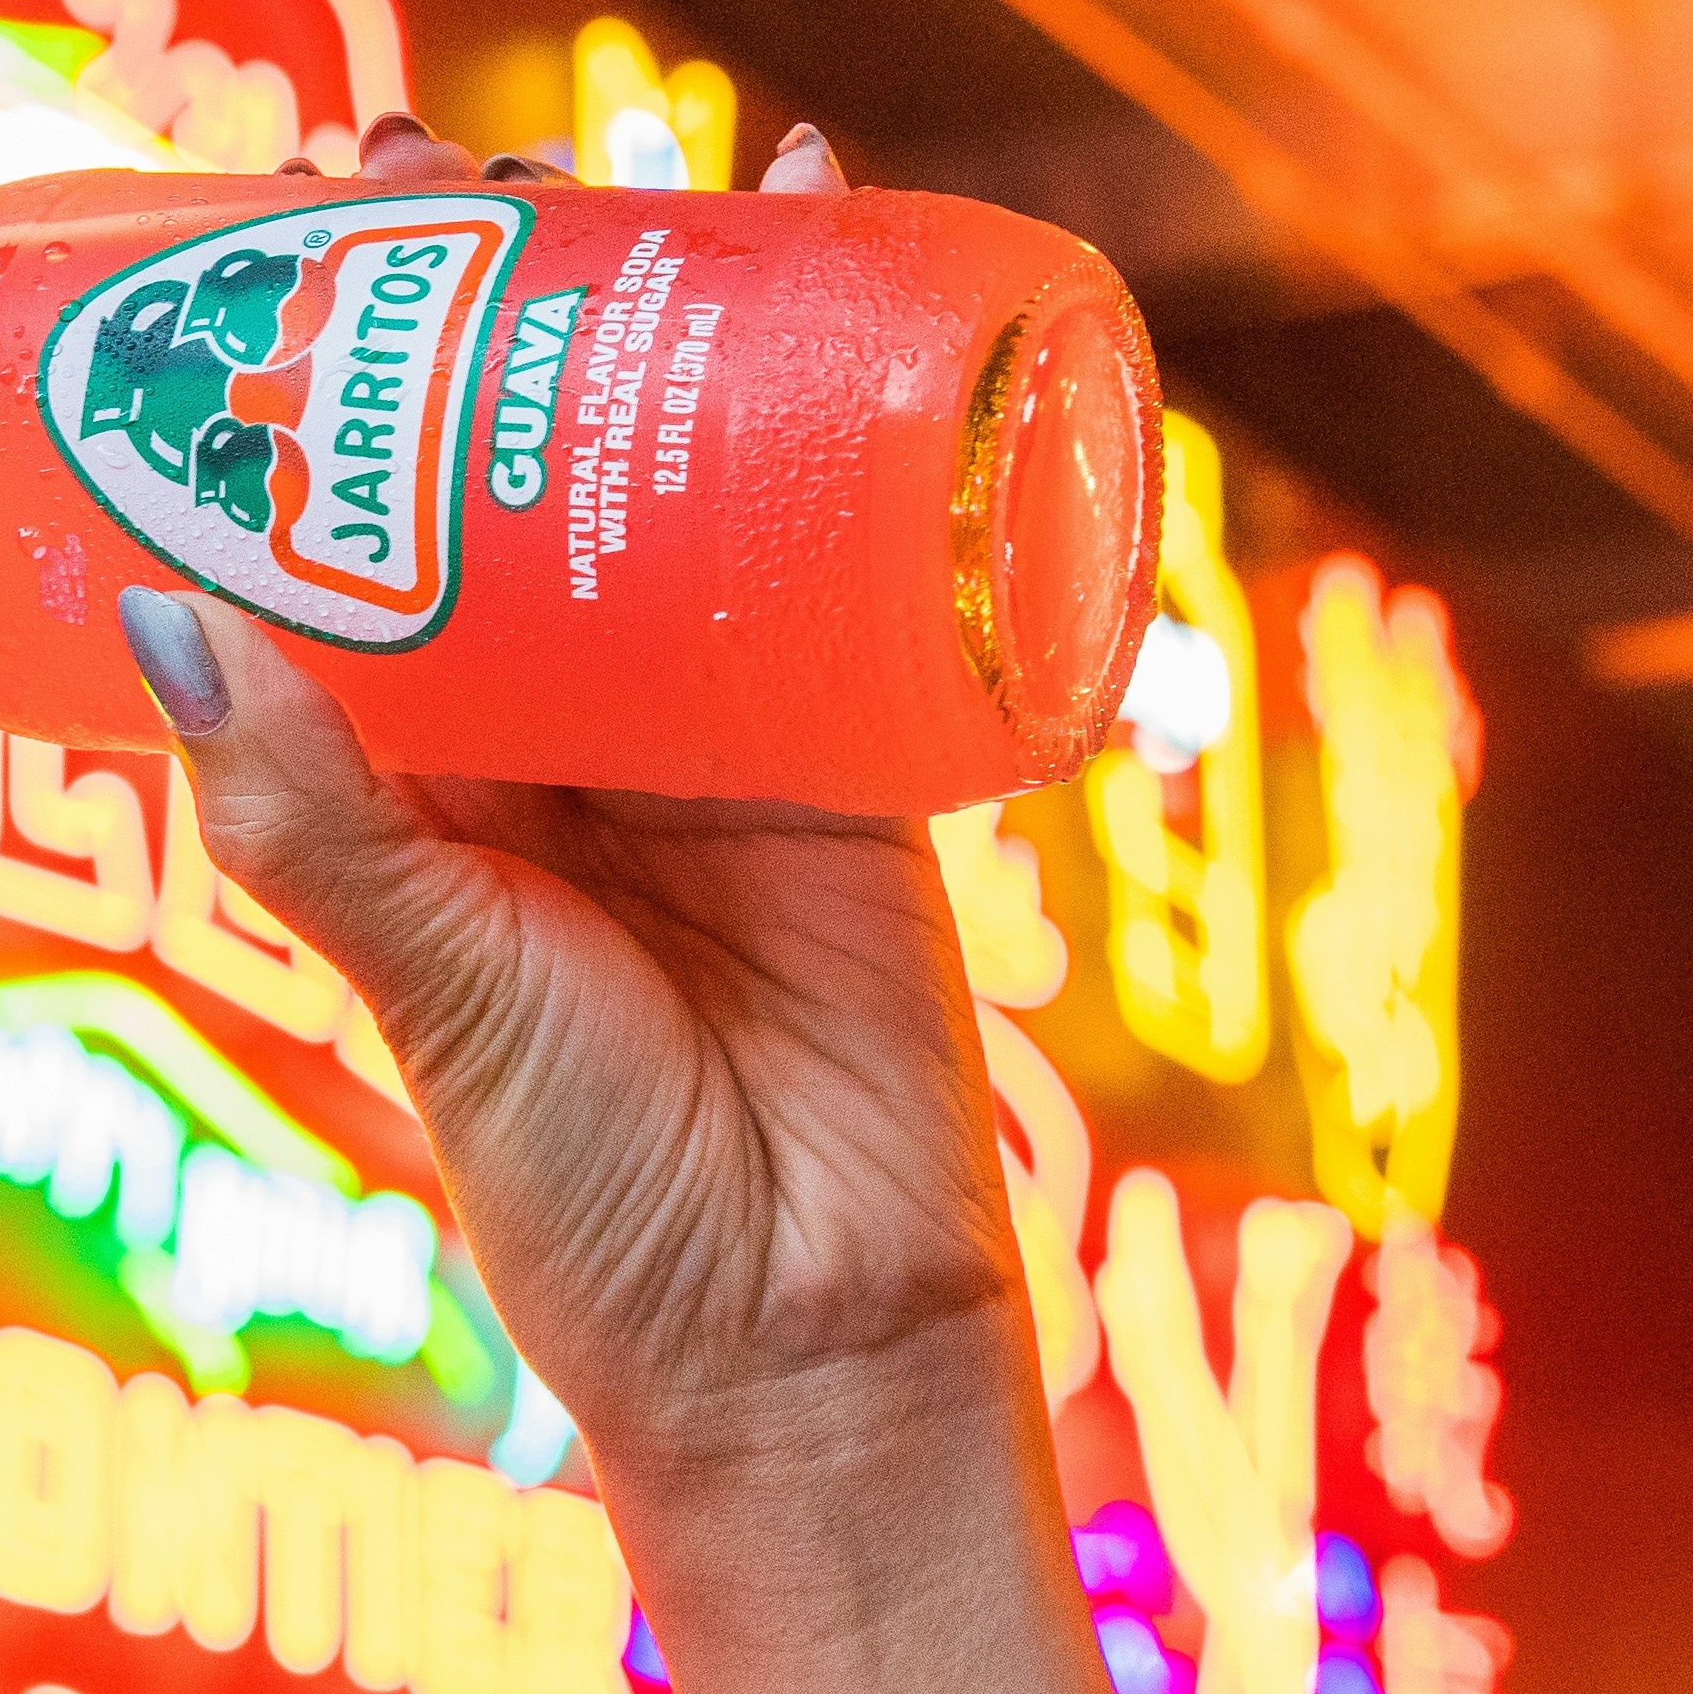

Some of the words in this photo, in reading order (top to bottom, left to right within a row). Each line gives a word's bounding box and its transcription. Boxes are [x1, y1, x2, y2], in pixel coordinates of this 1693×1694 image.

[613, 228, 671, 293] SODA
[626, 256, 685, 353] SUGAR
[330, 244, 449, 563] JARRITOS
[491, 291, 583, 506] GUAVA
[578, 301, 634, 425] FLAVOR
[604, 361, 647, 450] REAL
[663, 340, 711, 382] (370
[663, 387, 700, 415] OZ
[653, 450, 690, 494] 12.5
[658, 419, 694, 444] FL
[568, 436, 603, 600] NATURAL
[599, 458, 630, 554] WITH
